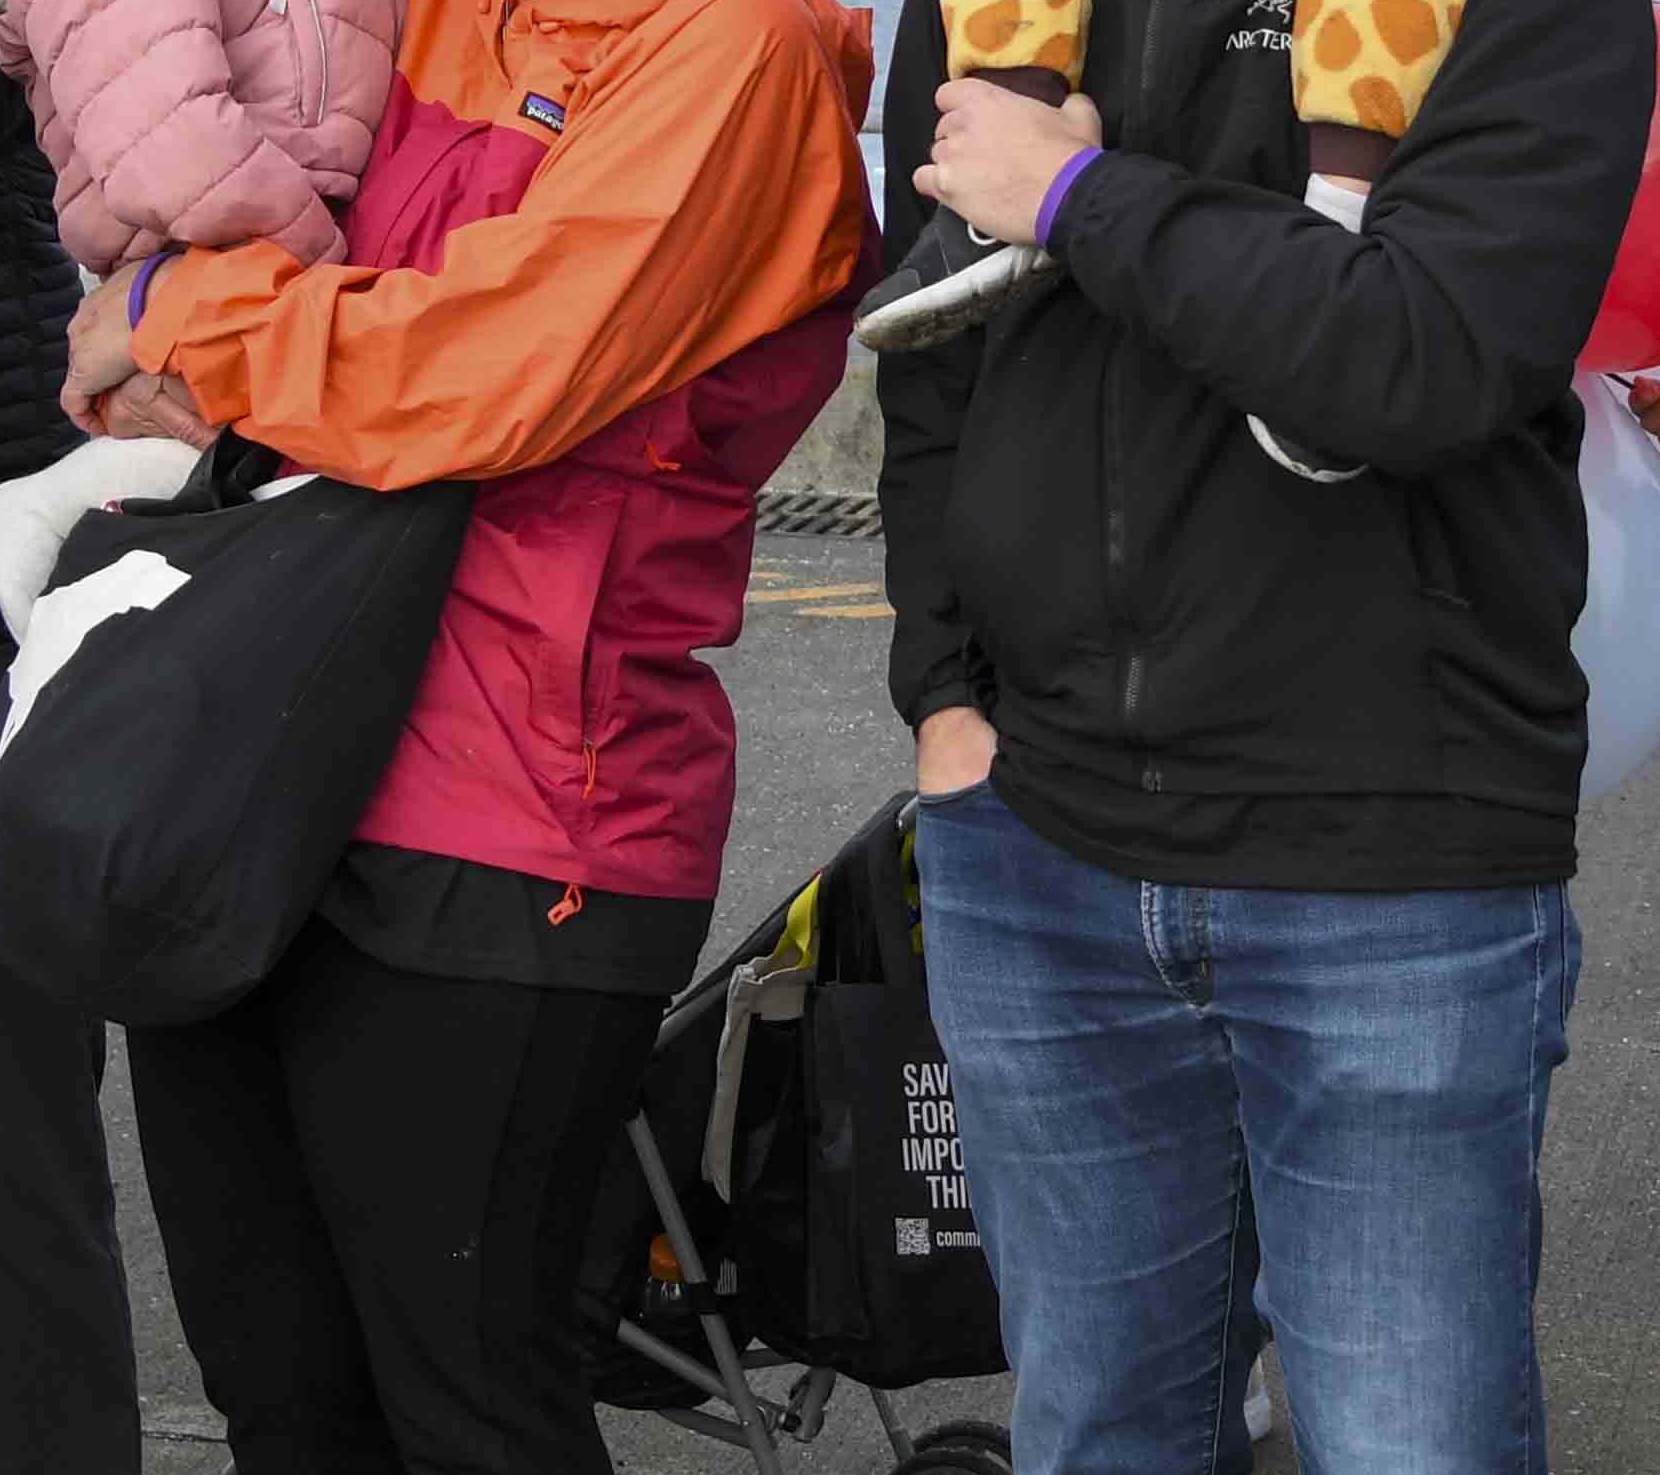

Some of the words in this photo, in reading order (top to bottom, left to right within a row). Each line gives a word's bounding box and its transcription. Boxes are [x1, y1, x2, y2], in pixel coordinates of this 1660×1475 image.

[907, 1100, 956, 1135] FOR
[901, 1137, 966, 1172] IMPO
[925, 1174, 973, 1210] THI
